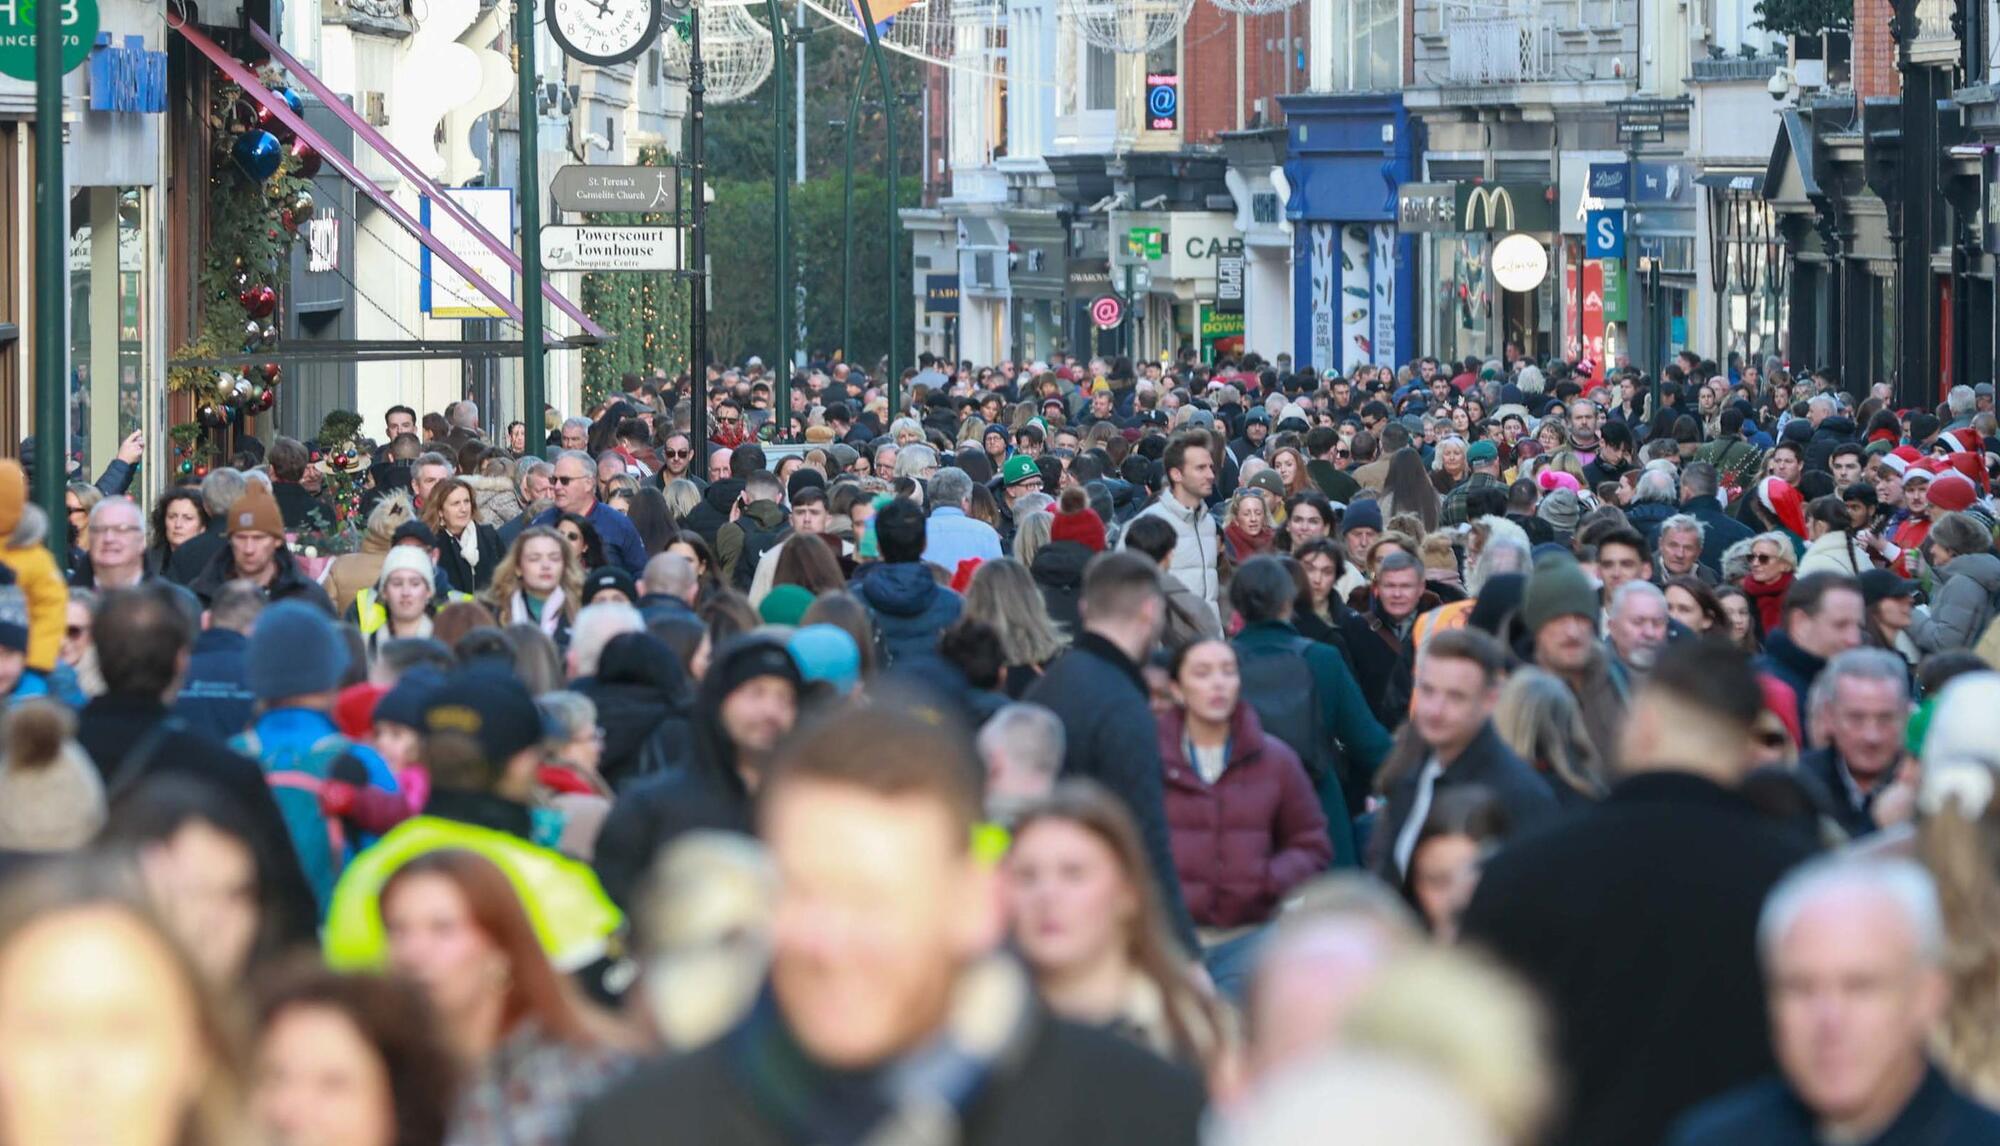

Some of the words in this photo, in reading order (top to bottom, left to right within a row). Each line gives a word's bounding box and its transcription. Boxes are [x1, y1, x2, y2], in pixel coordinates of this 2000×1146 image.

[588, 177, 599, 186] St.
[602, 177, 635, 186] Teresa's
[576, 191, 614, 200] Carmelite
[616, 191, 645, 200] Church
[576, 229, 664, 241] Powerscourt
[576, 243, 654, 256] Townhouse
[575, 259, 611, 267] Shopping
[614, 259, 639, 267] Centre
